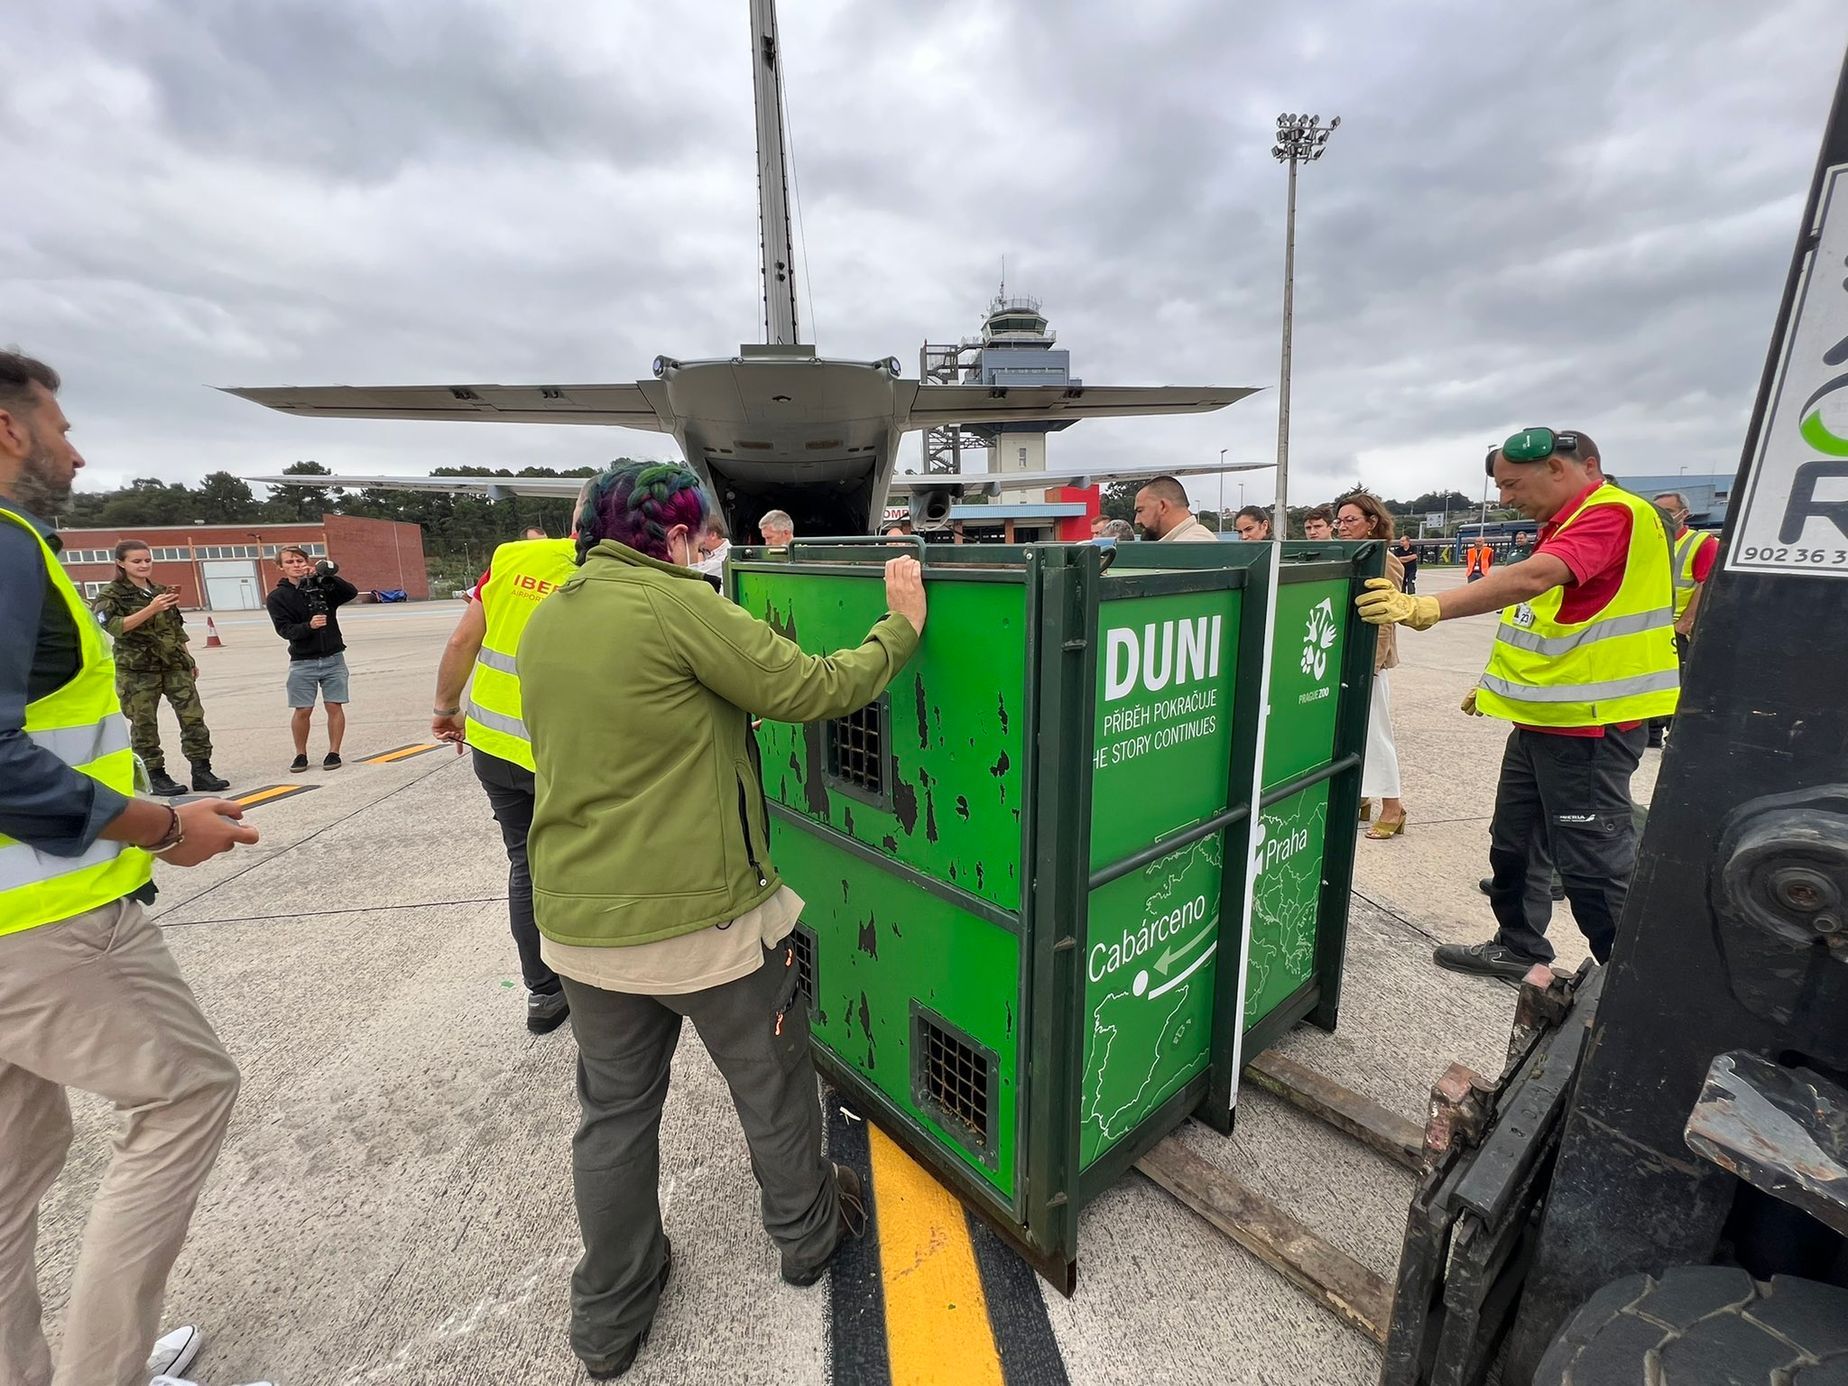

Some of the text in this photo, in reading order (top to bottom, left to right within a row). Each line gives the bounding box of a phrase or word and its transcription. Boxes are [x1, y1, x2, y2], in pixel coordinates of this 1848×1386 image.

[1744, 547, 1788, 562] 902
[1794, 549, 1825, 563] 36
[511, 589, 544, 602] AIRPOR
[1105, 615, 1221, 701] DUNI
[1103, 689, 1217, 737] PŘÍBĚH POKRAČUJE
[1318, 686, 1330, 699] ZOO
[1093, 715, 1216, 770] HE STORY CONTINUES
[1265, 827, 1308, 869] Praha
[1088, 895, 1206, 983] Cabárceno
